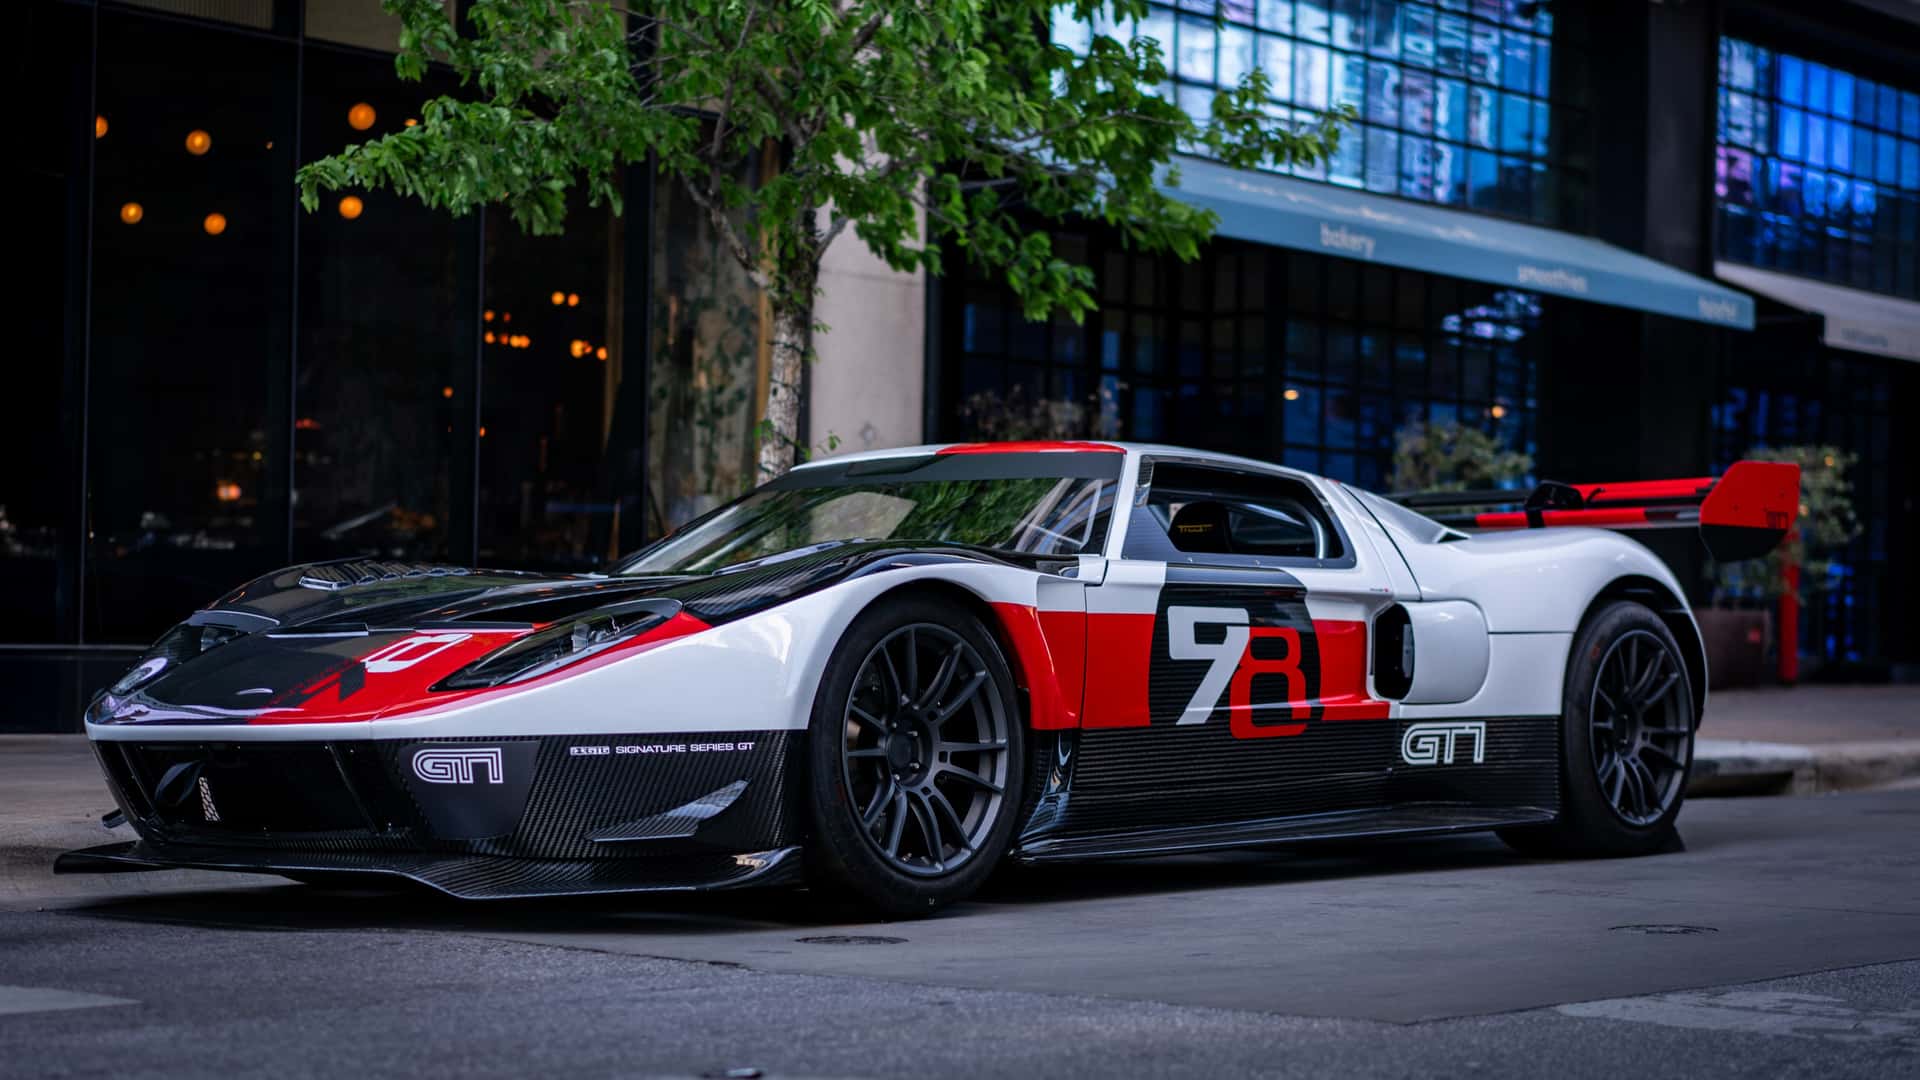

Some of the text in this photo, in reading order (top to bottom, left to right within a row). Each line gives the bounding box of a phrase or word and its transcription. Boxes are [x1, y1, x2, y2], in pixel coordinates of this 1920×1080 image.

[1167, 605, 1310, 739] 98
[615, 744, 686, 754] SIGNATURE
[690, 742, 734, 752] SERIES
[737, 742, 755, 750] GT
